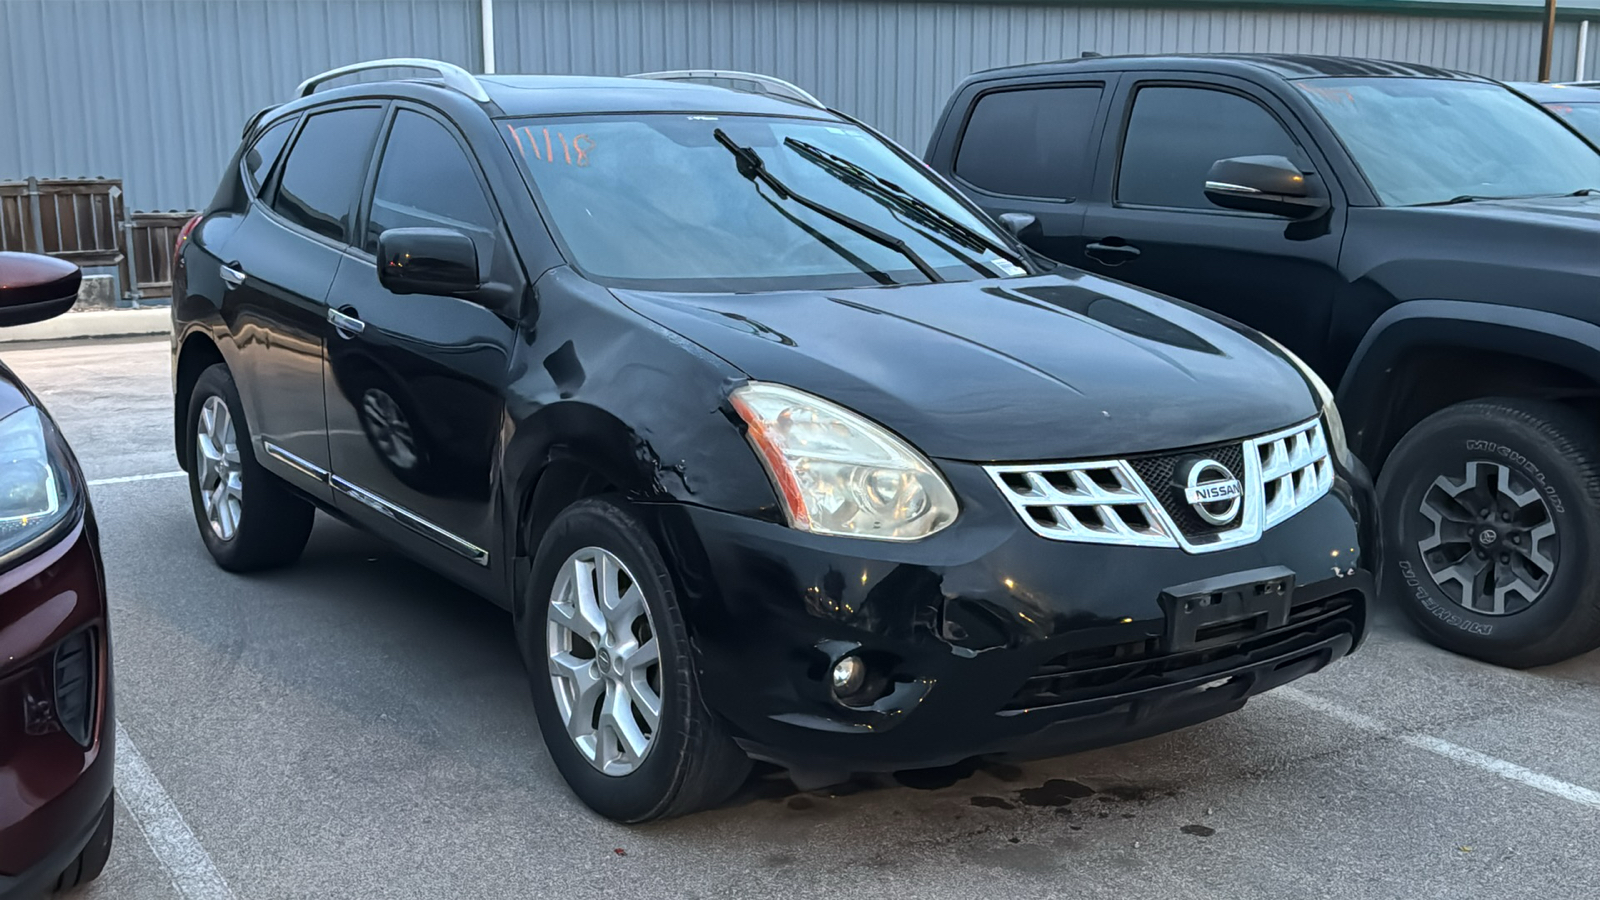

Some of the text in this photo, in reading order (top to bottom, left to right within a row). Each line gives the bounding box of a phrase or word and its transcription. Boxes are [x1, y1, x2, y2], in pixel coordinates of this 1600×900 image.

[1195, 484, 1240, 500] NISSAN
[1466, 439, 1565, 513] MICHELIN
[1399, 561, 1494, 635] MICHELIN
